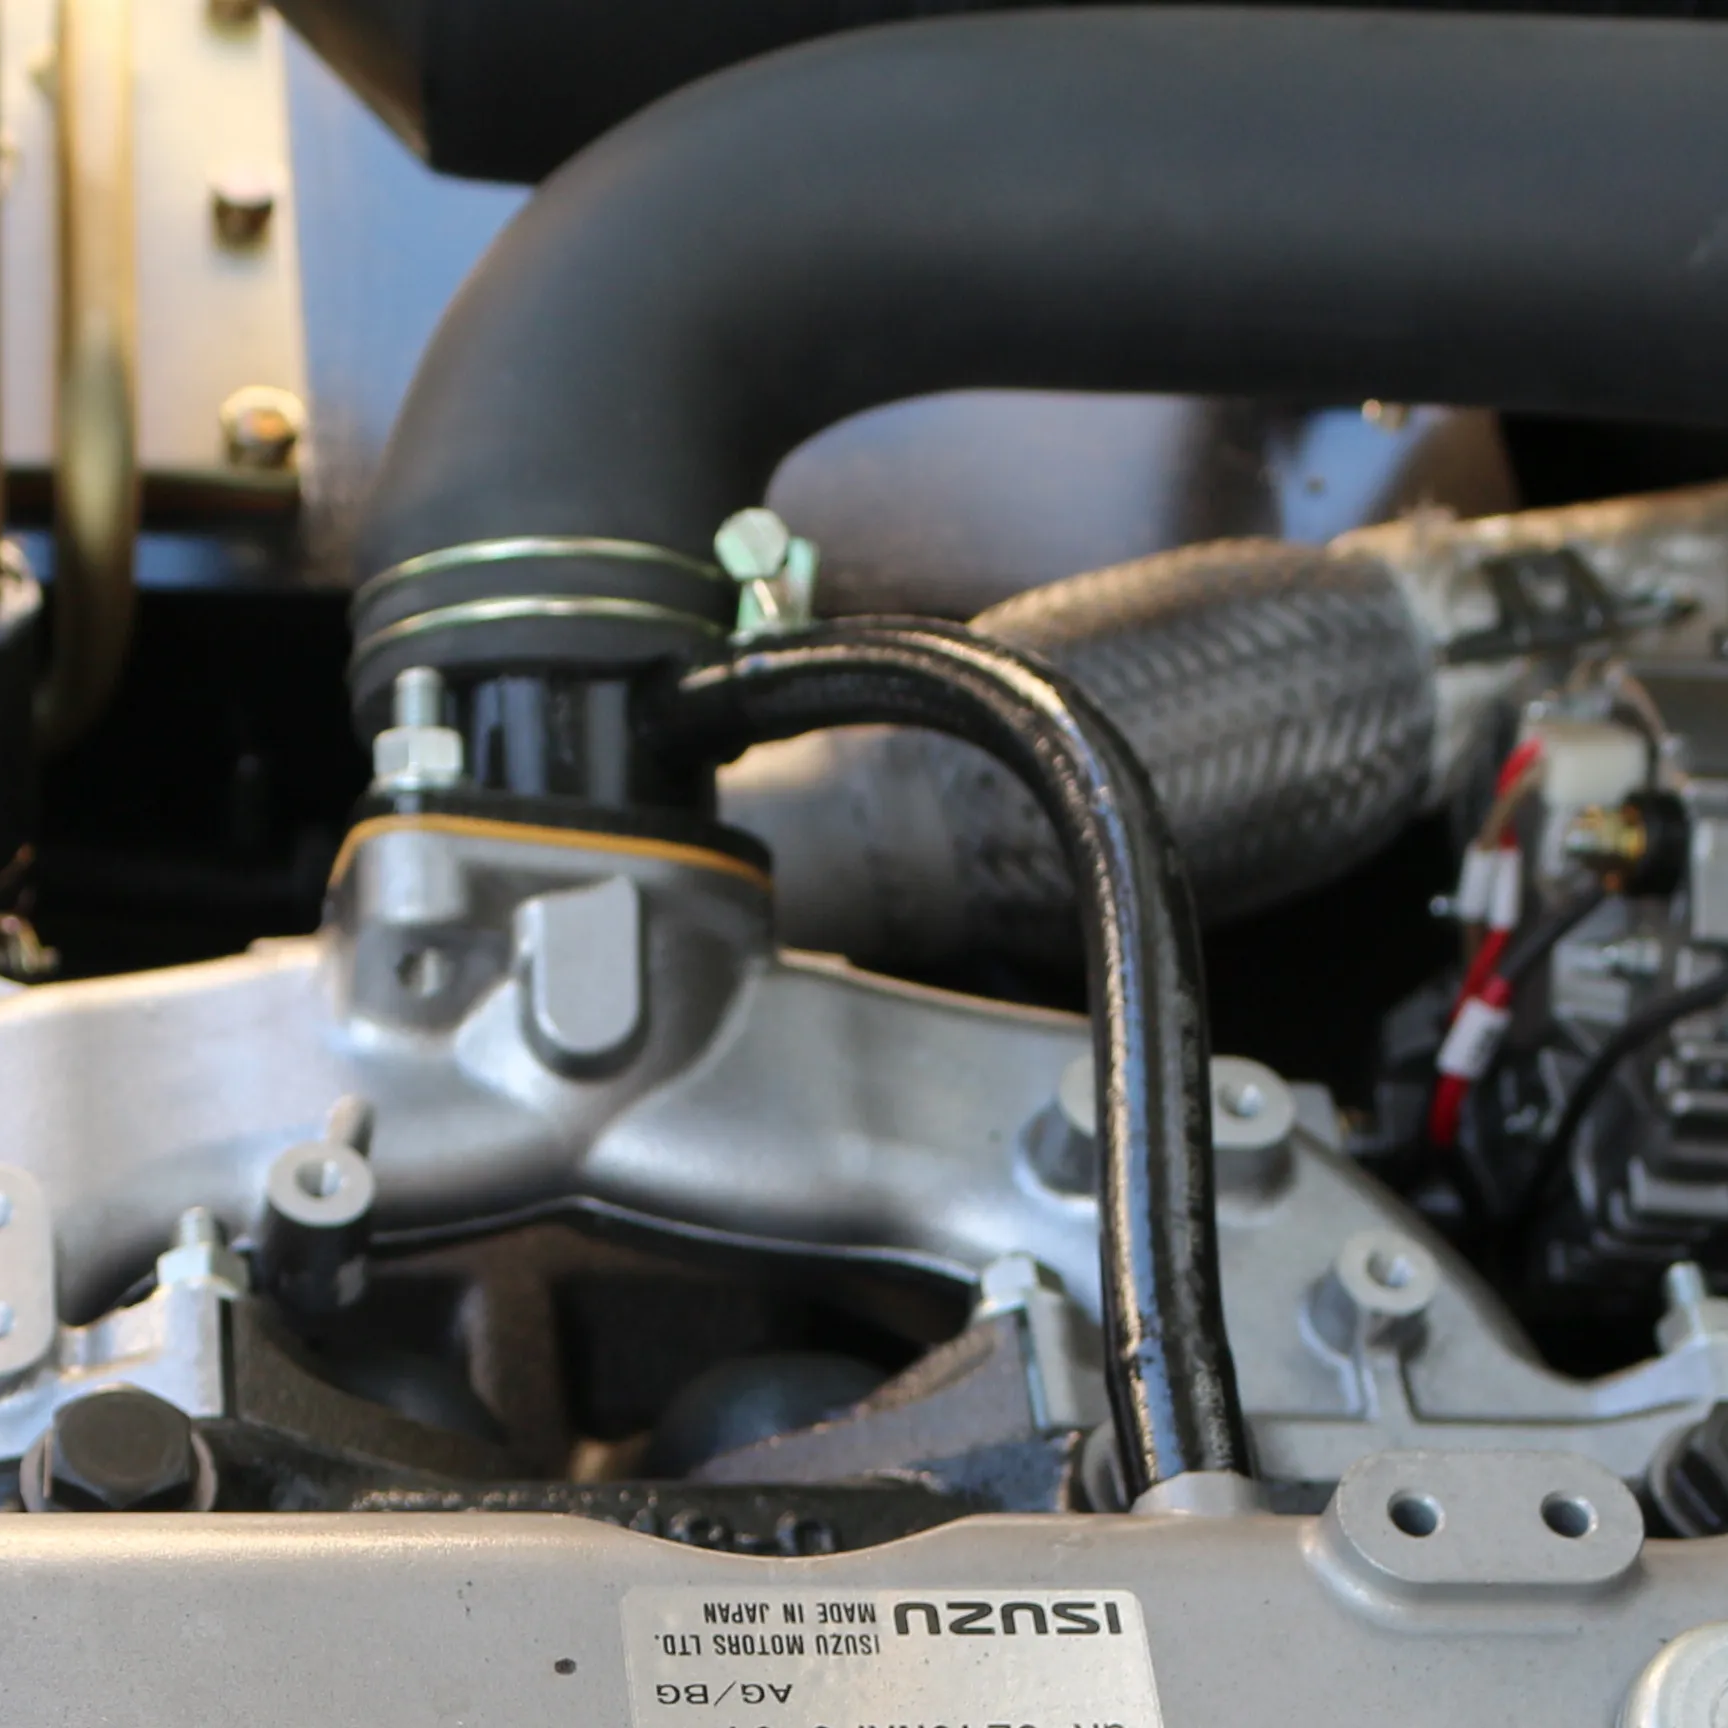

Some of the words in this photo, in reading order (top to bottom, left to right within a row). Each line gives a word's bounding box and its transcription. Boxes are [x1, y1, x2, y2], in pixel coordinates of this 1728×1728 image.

[703, 1603, 771, 1624] JAPAN
[783, 1603, 805, 1624] IN
[817, 1603, 877, 1625] MADE
[893, 1601, 1123, 1636] ISUZU
[654, 1633, 702, 1655] LTD.
[714, 1634, 805, 1656] MOTORS
[817, 1634, 881, 1656] ISUZU
[655, 1681, 794, 1707] AG/BG
